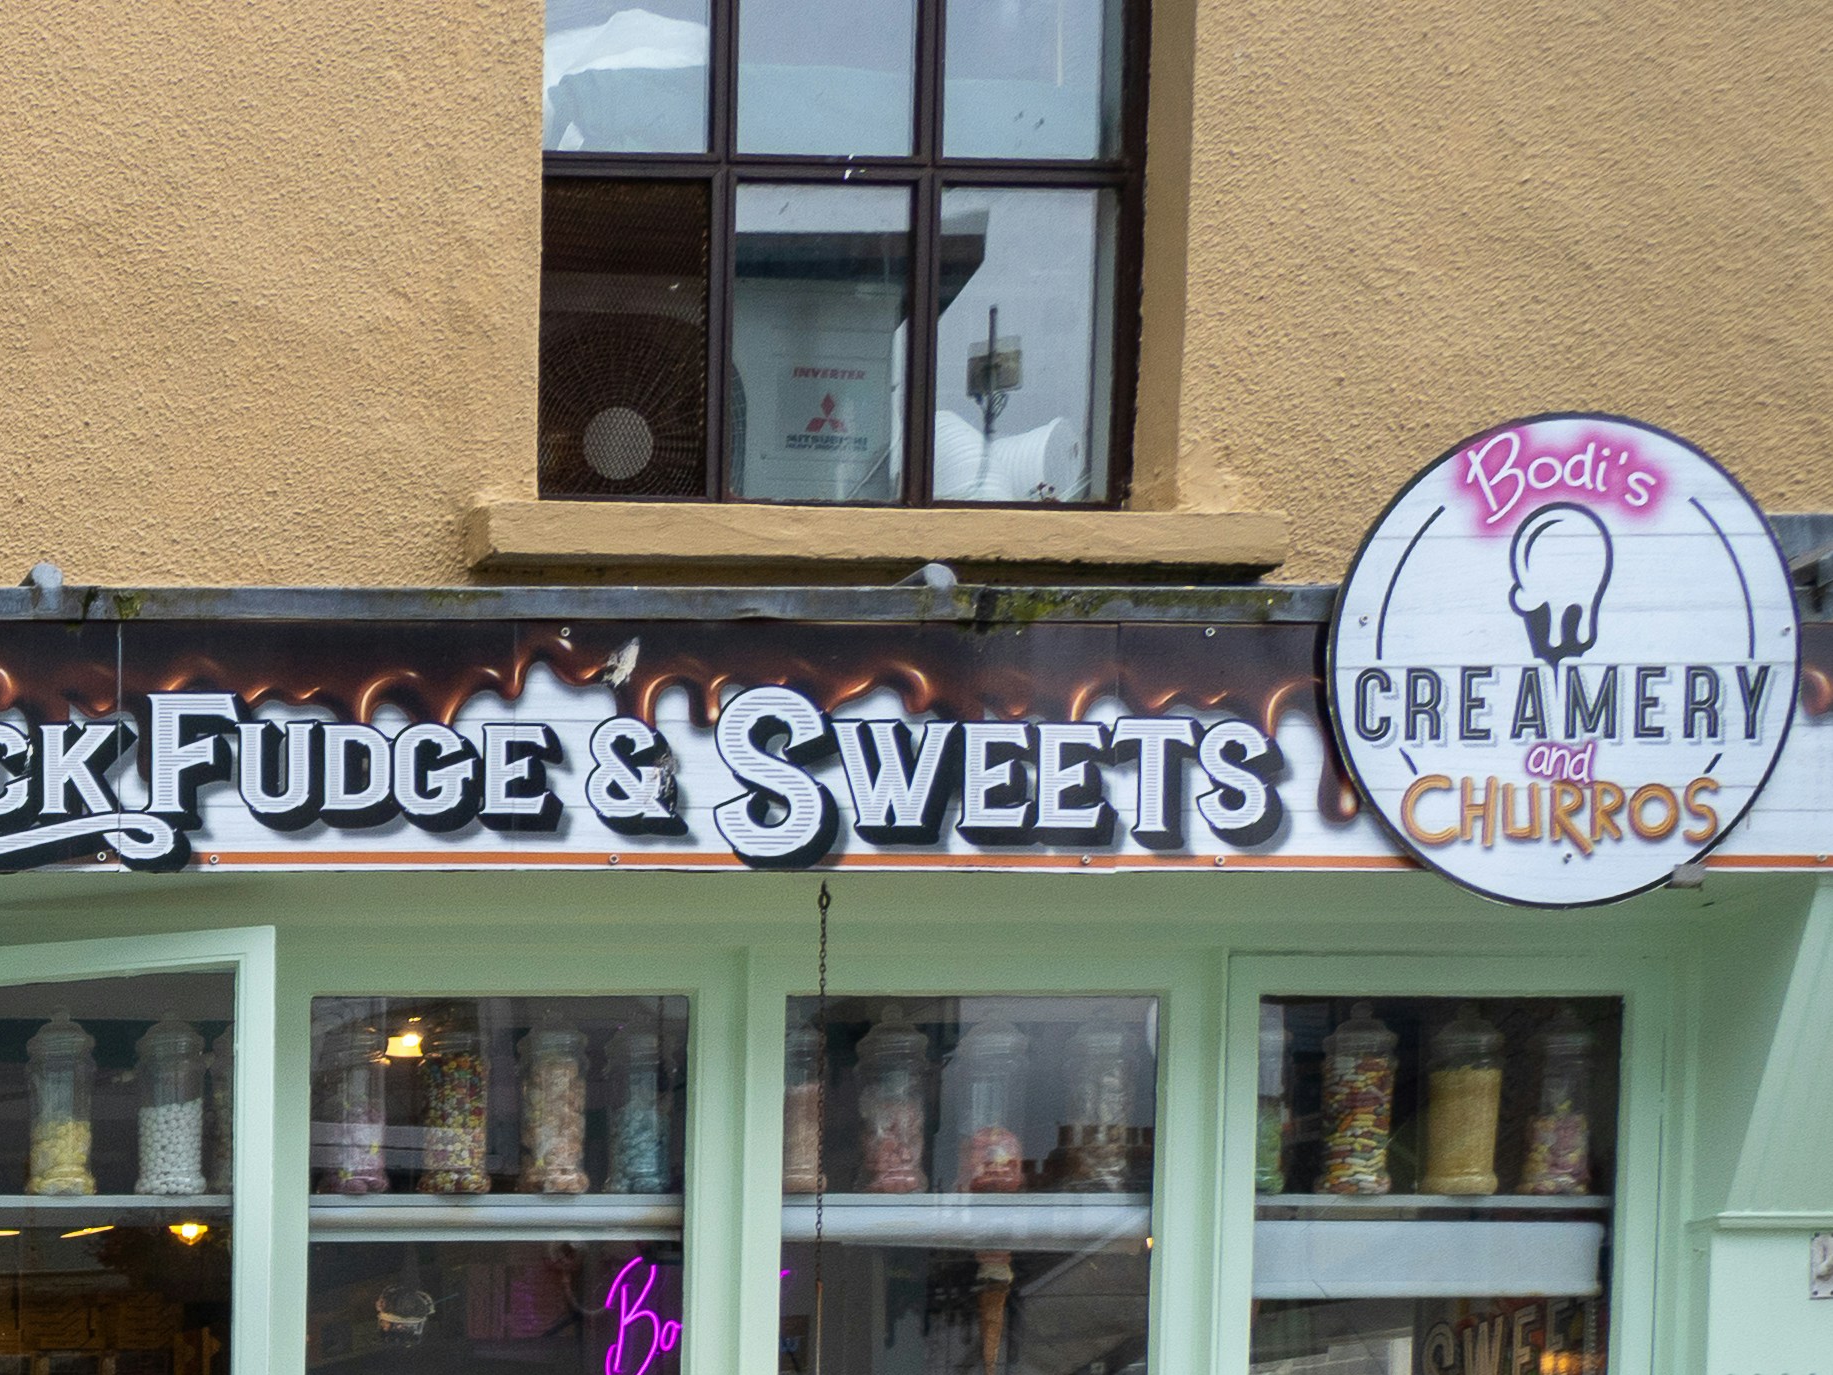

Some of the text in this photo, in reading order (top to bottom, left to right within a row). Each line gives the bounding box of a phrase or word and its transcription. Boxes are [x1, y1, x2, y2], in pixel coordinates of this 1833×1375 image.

[793, 367, 866, 379] INVERTER
[1462, 428, 1657, 528] Bodi's
[1355, 664, 1772, 745] CREAMERY
[146, 693, 564, 835] FUDGE
[585, 716, 686, 838] &
[713, 685, 1282, 867] SWEETS
[1525, 738, 1592, 782] and
[1401, 774, 1719, 853] CHURROS
